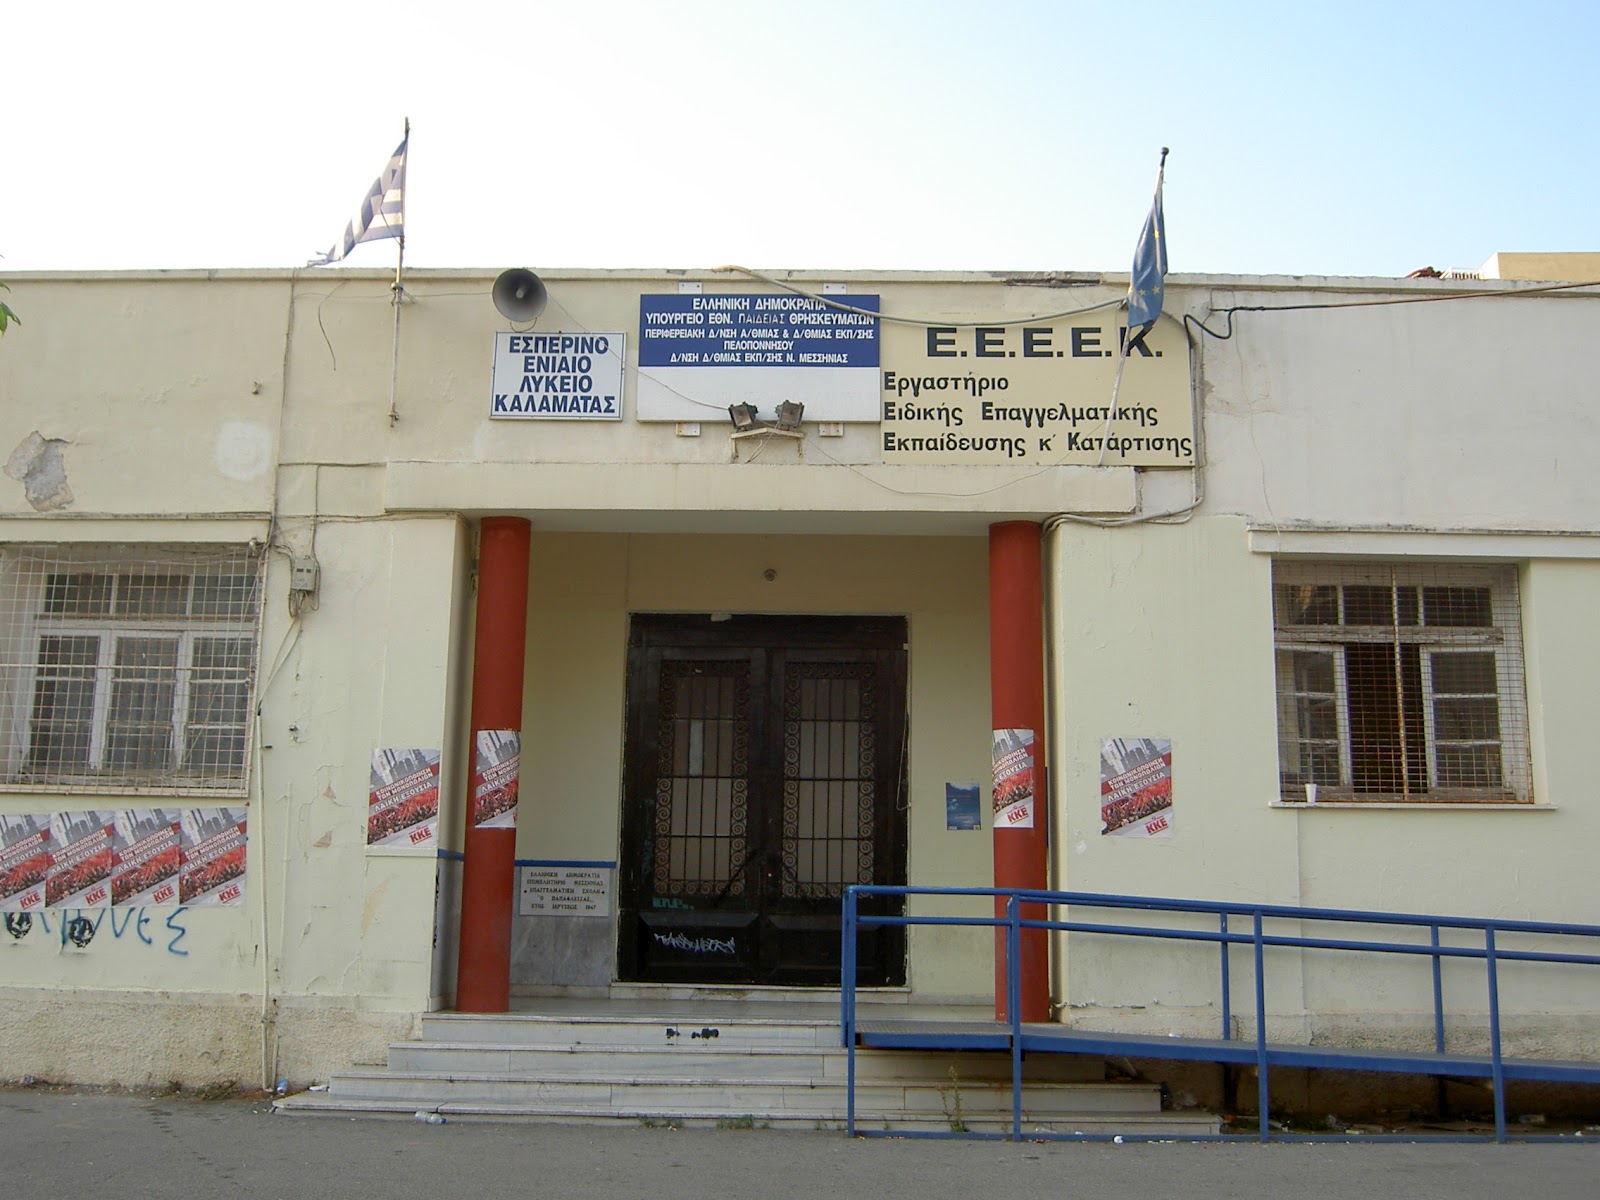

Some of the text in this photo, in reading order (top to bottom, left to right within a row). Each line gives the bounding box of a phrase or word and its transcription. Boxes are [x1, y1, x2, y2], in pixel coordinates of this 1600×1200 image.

[692, 298, 826, 311] ΕΛΛΗΝΙΚΗ ΔΗΜΟΚΡΑΤΙΑ
[646, 313, 874, 325] ΥΠΟΥΡΓΕΙΟ ΕΘΝ. ΠΑΙΔΕΙΑΣ ΘΡΗΣΚΕΥΜΑΤΩΝ
[645, 328, 874, 339] ΠΕΡΙΦΕΡΕΙΑΚΗ Δ/ΝΣΗ Α/ΘΜΙΑΣ & Δ/ΘΜΙΑΣ ΕΚΠ/ΣΗΣ
[509, 336, 608, 354] ΕΣΠΕΡΙΝΟ
[724, 340, 794, 351] ΠΕΛΟΠΟΝΝΗΣΟΥ
[523, 356, 592, 374] ΕΝΙΑΙΟ
[670, 353, 848, 364] Δ/ΝΣΗ Δ/ΘΜΙΑΣ ΕΚΠ/ΣΗΣ Ν. ΜΕΣΣΗΝΙΑΣ
[519, 375, 593, 393] ΛΥΚΕΙΟ
[883, 371, 1009, 398] Εργαστήριο
[494, 395, 616, 414] ΚΑΛΑΜΑΤΑΣ
[883, 401, 1158, 428] Ειδικής Επαγγελματικής
[883, 432, 1026, 458] Εκπαίδευσης
[1067, 432, 1192, 458] Κατάρτισης
[1007, 807, 1028, 822] ΚΚΕ
[1146, 818, 1168, 833] ΚΚΕ
[409, 828, 432, 843] ΚΚΕ
[20, 892, 40, 908] ΚΚΕ
[86, 888, 106, 904] ΚΚΕ
[153, 886, 174, 902] ΚΚΕ
[218, 885, 240, 902] ΚΚΕ
